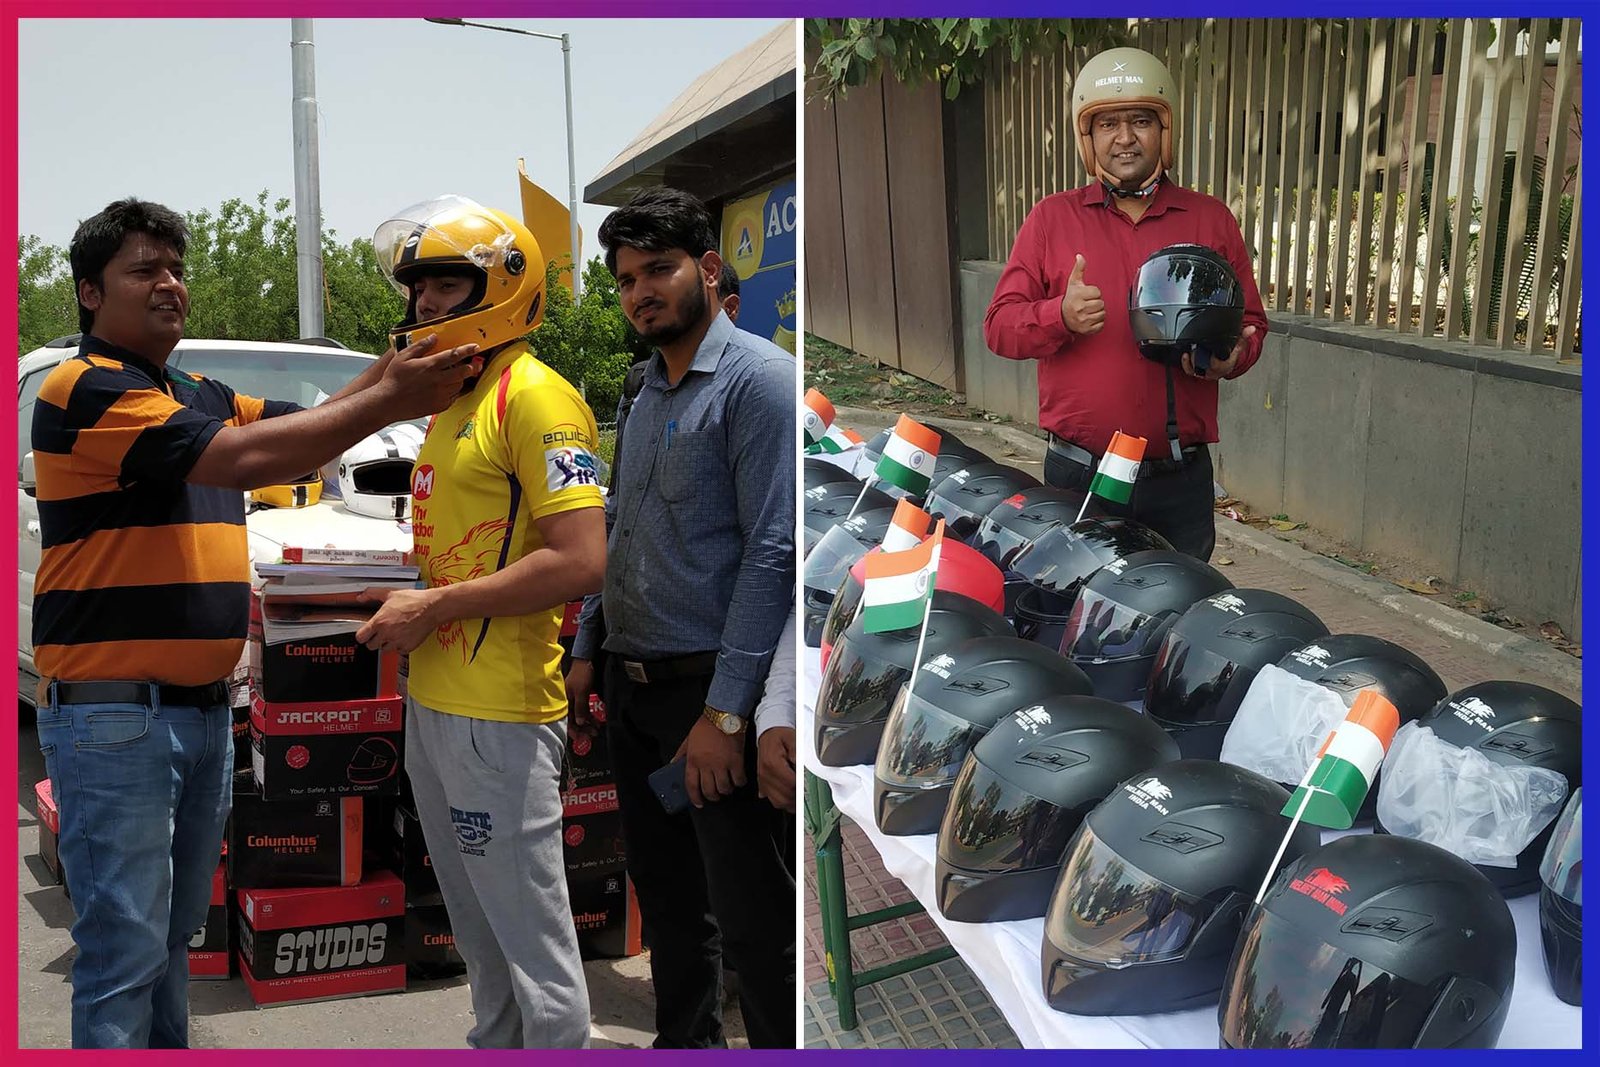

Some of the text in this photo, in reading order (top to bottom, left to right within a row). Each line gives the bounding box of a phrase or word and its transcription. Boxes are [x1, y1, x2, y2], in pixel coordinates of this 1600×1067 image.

[1095, 75, 1144, 87] HELMET MAN
[285, 643, 355, 657] Columbus
[312, 656, 355, 664] HELMET
[277, 710, 362, 724] JACKPOT
[323, 723, 359, 732] HELMET
[561, 789, 617, 806] JACKPO
[595, 802, 619, 811] HELME
[248, 834, 317, 848] Columbus
[274, 846, 317, 854] HELMET
[274, 922, 388, 975] STUDDS
[293, 974, 340, 984] PROTECTION
[343, 968, 393, 979] TECHNOLOGY
